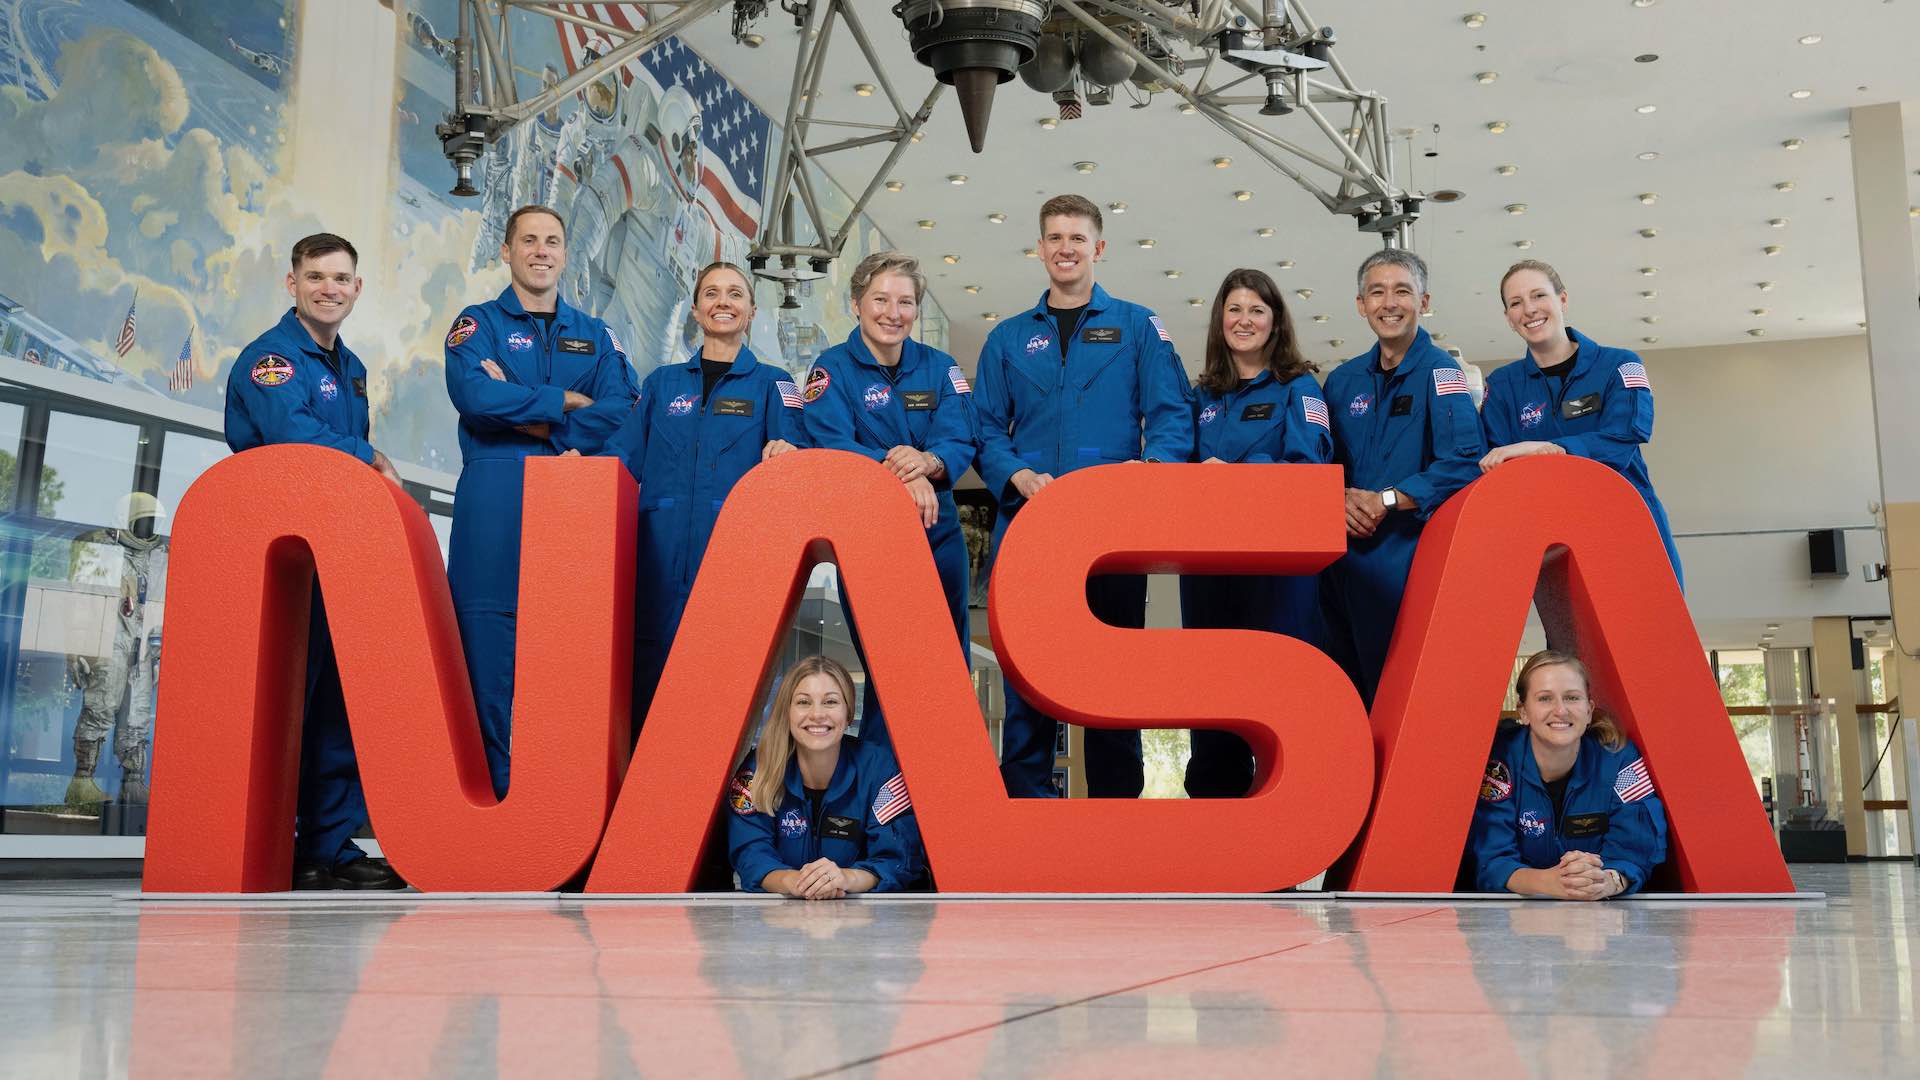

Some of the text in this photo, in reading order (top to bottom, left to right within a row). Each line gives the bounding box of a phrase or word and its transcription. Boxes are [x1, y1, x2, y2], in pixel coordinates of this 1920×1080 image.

[1026, 339, 1049, 349] NASA
[864, 392, 890, 403] NASA
[143, 444, 1794, 893] NASA
